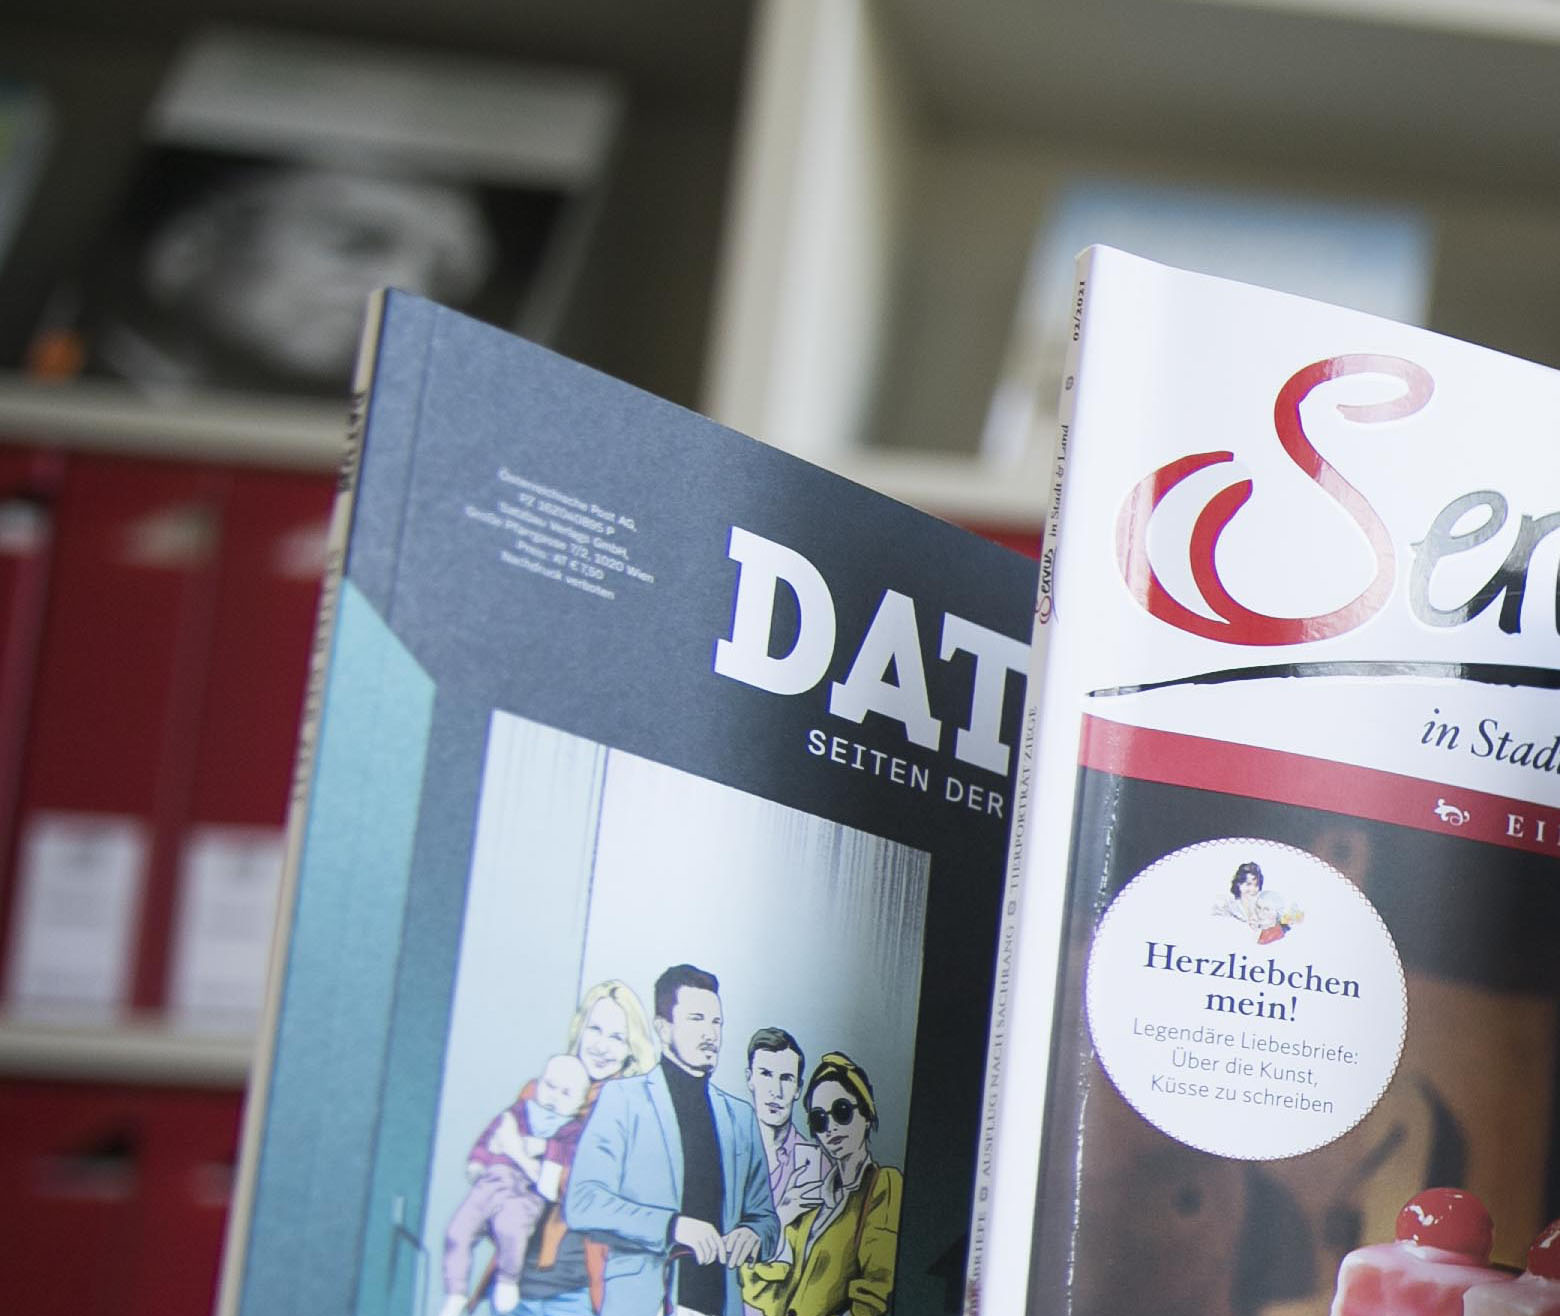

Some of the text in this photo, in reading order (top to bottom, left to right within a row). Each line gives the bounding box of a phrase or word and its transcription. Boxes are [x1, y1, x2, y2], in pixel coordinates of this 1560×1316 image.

[1049, 424, 1069, 519] Stadt Land
[594, 553, 655, 584] 1020 Wien
[1421, 708, 1461, 750] in
[807, 729, 1004, 819] SEITEN DER
[1144, 941, 1360, 998] Herzliebchen
[1205, 992, 1297, 1021] mein!
[990, 1032, 1004, 1087] NACH
[1133, 1017, 1358, 1064] Legendäre Liebesbriefe:
[1171, 1046, 1318, 1087] Über die Kunst,
[1151, 1075, 1333, 1114] Küsse zu schreiben
